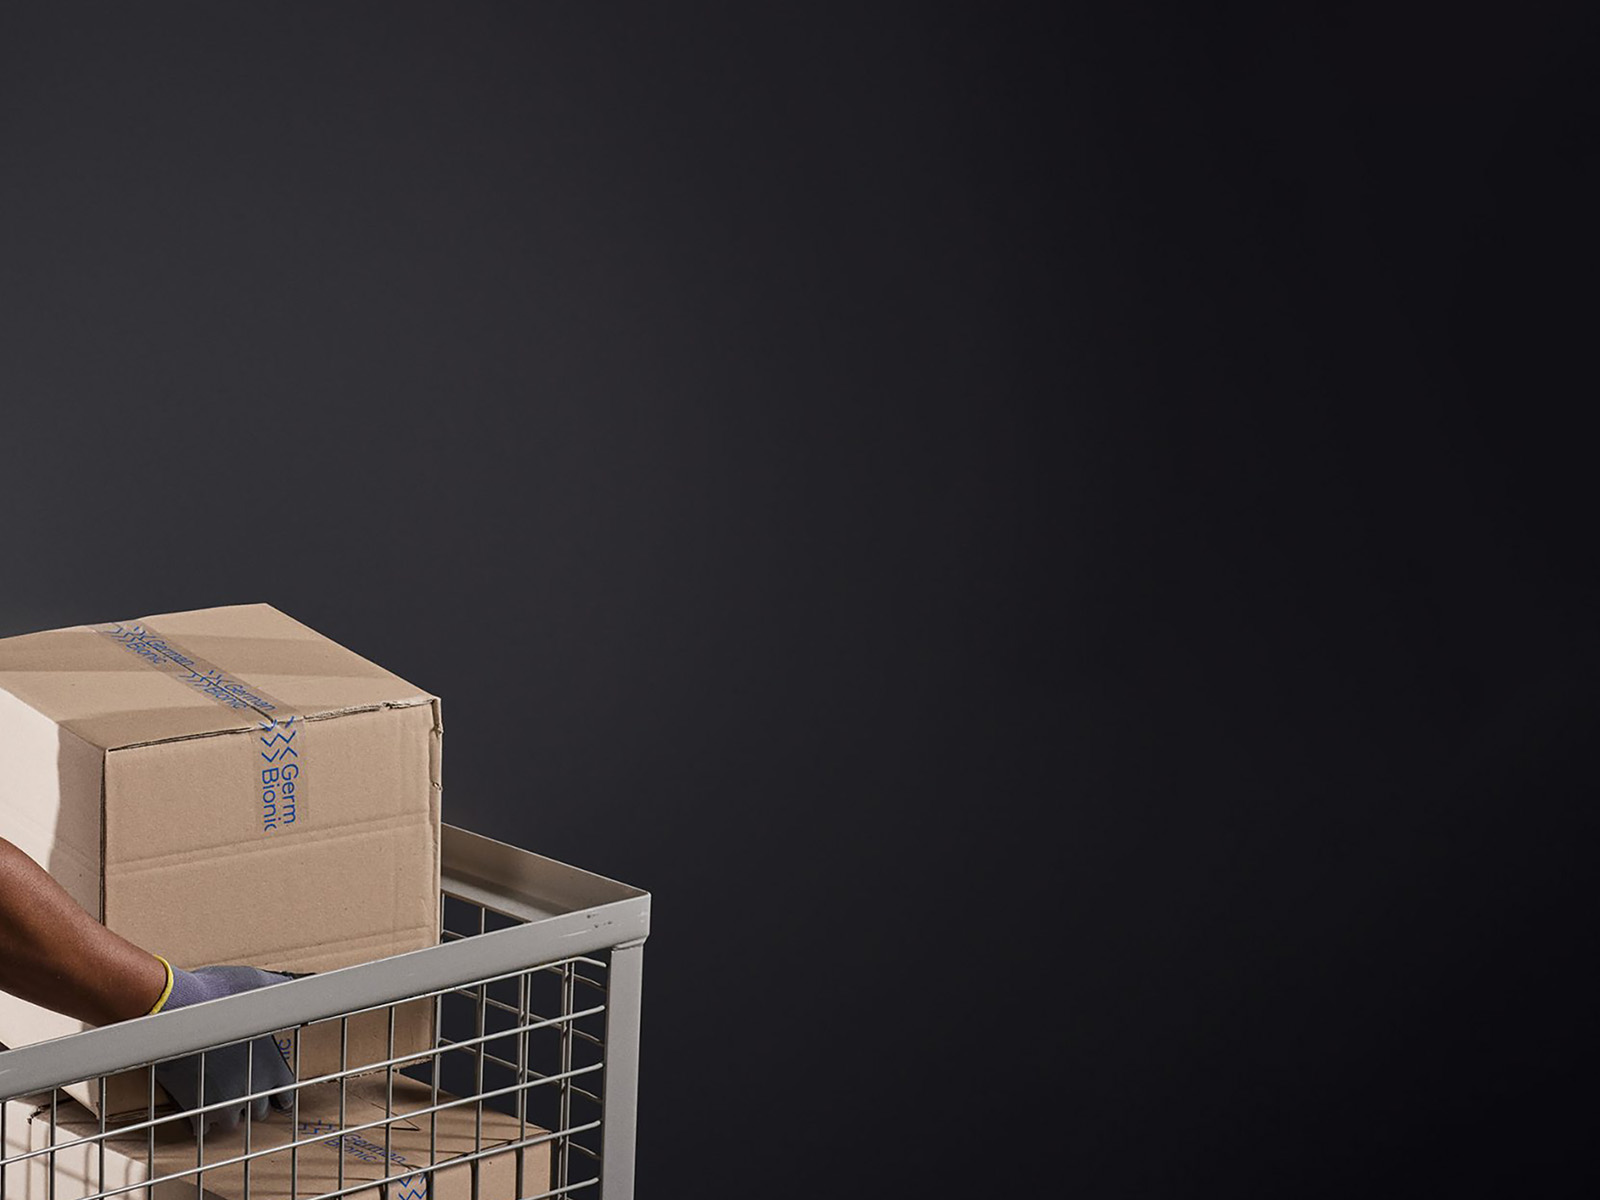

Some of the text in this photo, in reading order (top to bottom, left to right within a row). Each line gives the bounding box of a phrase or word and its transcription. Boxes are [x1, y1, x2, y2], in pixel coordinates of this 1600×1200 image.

[126, 642, 167, 664] Bionic
[146, 639, 194, 666] German
[205, 686, 247, 709] Bionic
[224, 684, 276, 711] German
[281, 763, 299, 824] Germ
